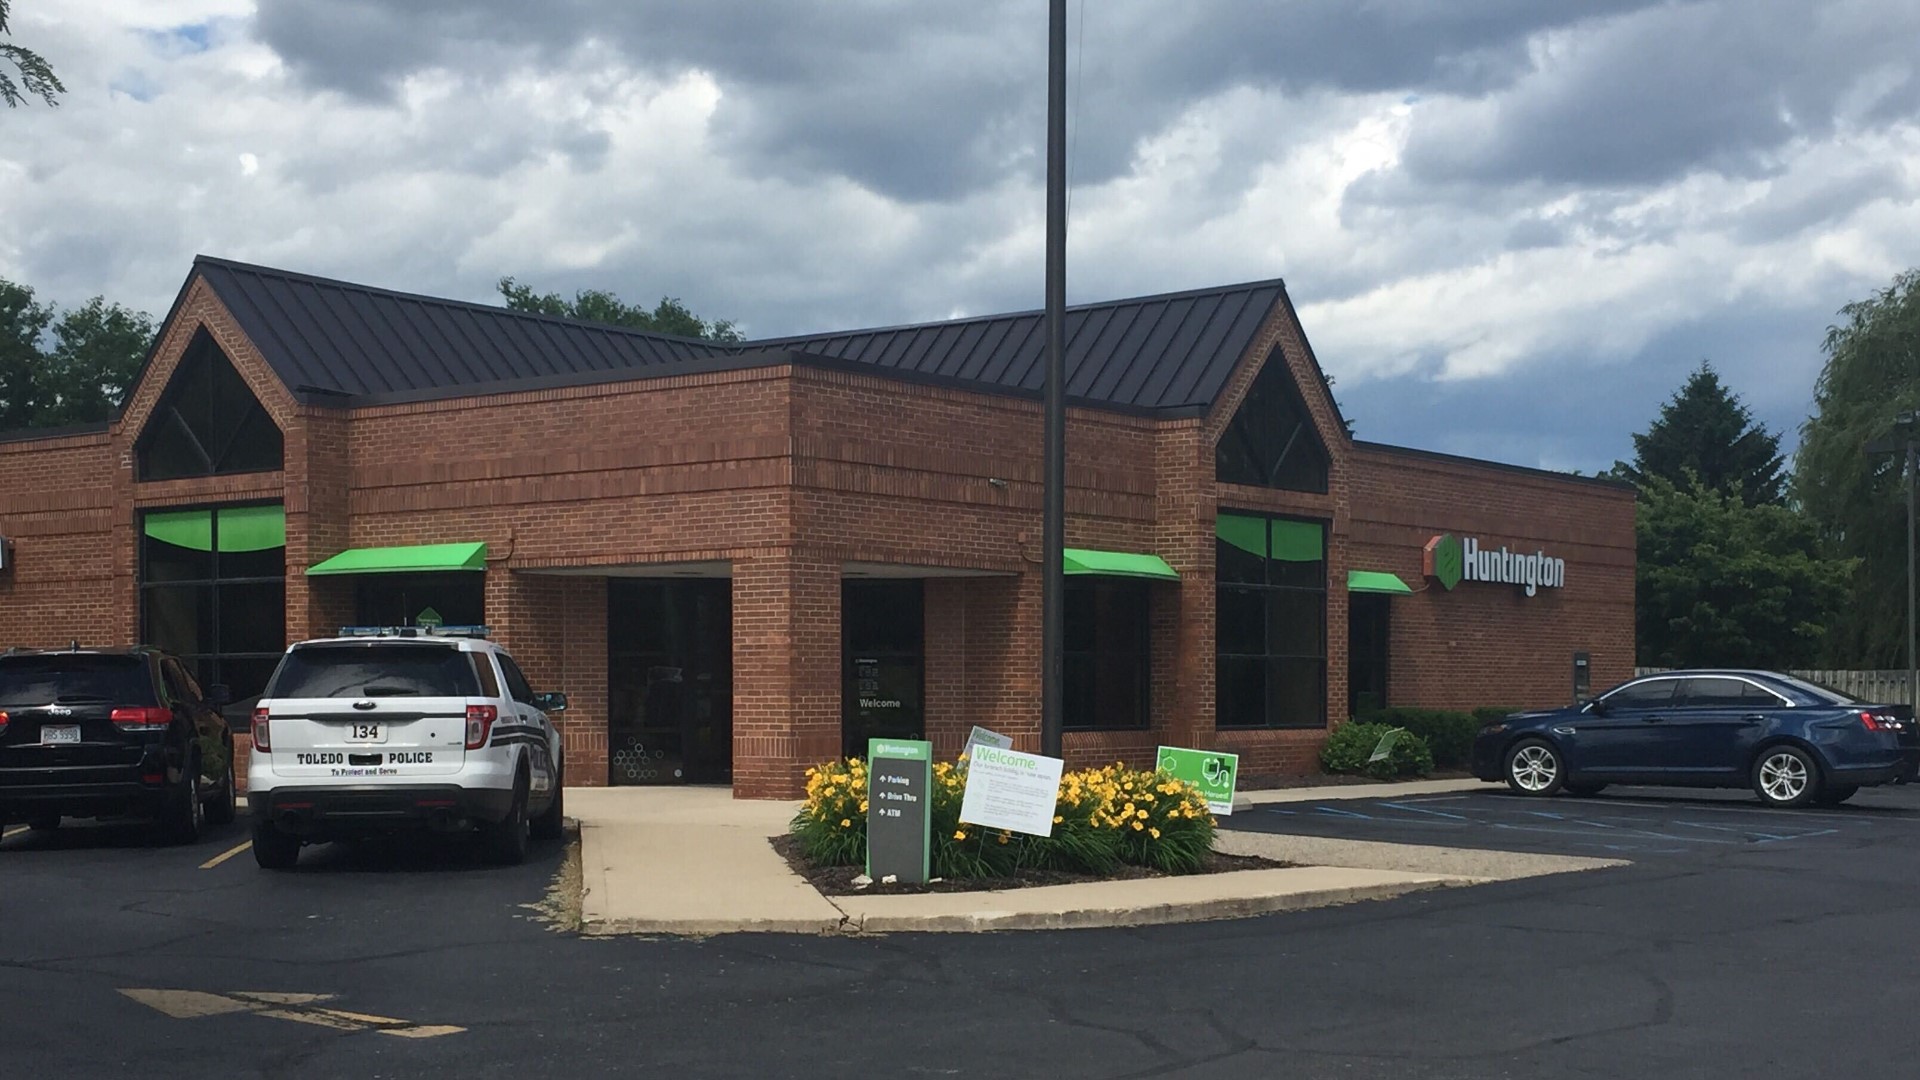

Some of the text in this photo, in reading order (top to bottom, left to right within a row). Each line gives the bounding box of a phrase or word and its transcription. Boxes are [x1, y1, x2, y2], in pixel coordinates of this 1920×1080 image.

[1463, 537, 1565, 598] Huntington
[860, 698, 901, 708] Welcome
[48, 704, 72, 716] Jeep
[352, 725, 379, 739] 134
[297, 752, 433, 765] TOLEDO POLICE
[976, 746, 1039, 771] Welcome.
[341, 768, 364, 776] Protect
[365, 767, 378, 775] and
[887, 775, 910, 786] Parking
[887, 792, 917, 802] Drive Thru
[886, 808, 901, 817] ATM
